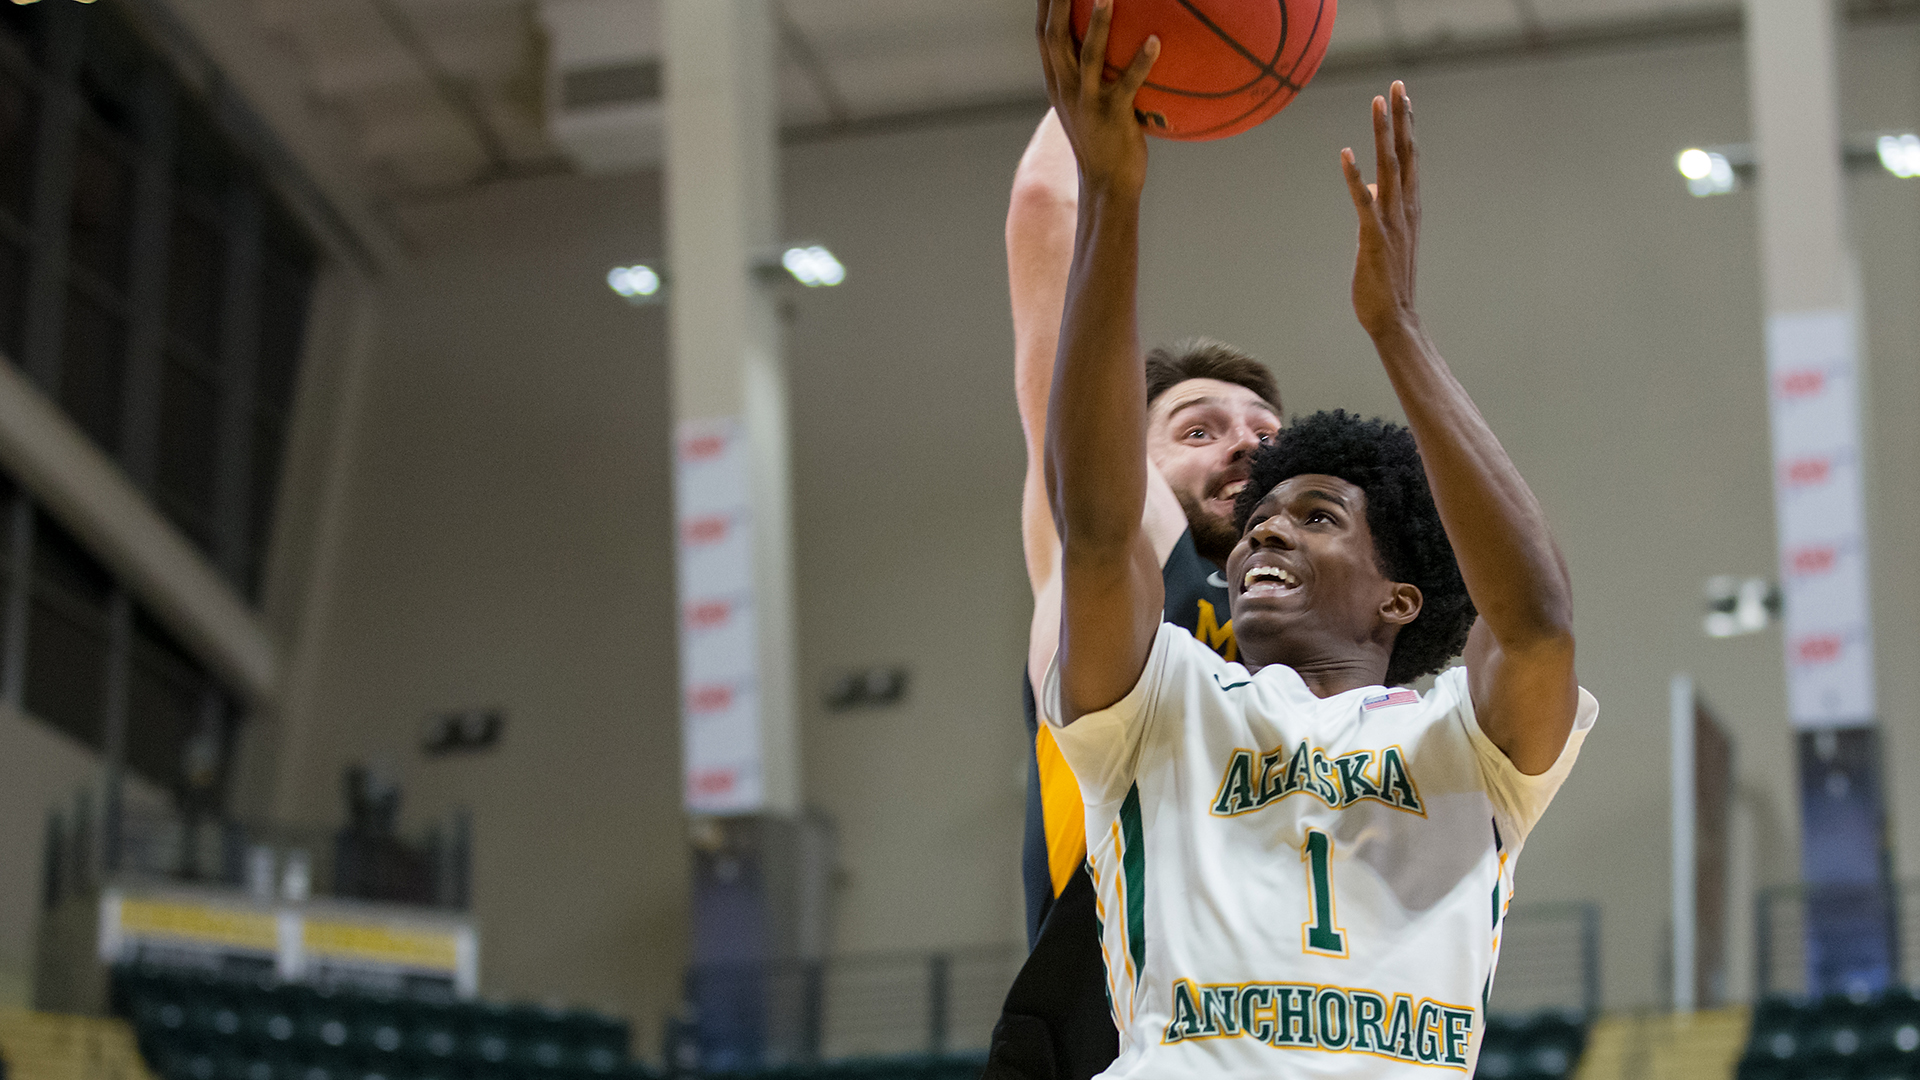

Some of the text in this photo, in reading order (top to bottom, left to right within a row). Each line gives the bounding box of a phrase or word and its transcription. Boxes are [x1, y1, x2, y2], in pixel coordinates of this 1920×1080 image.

[1210, 738, 1428, 819] ALASKA
[1301, 826, 1349, 959] 1
[1160, 977, 1474, 1073] ANCHORAGE
